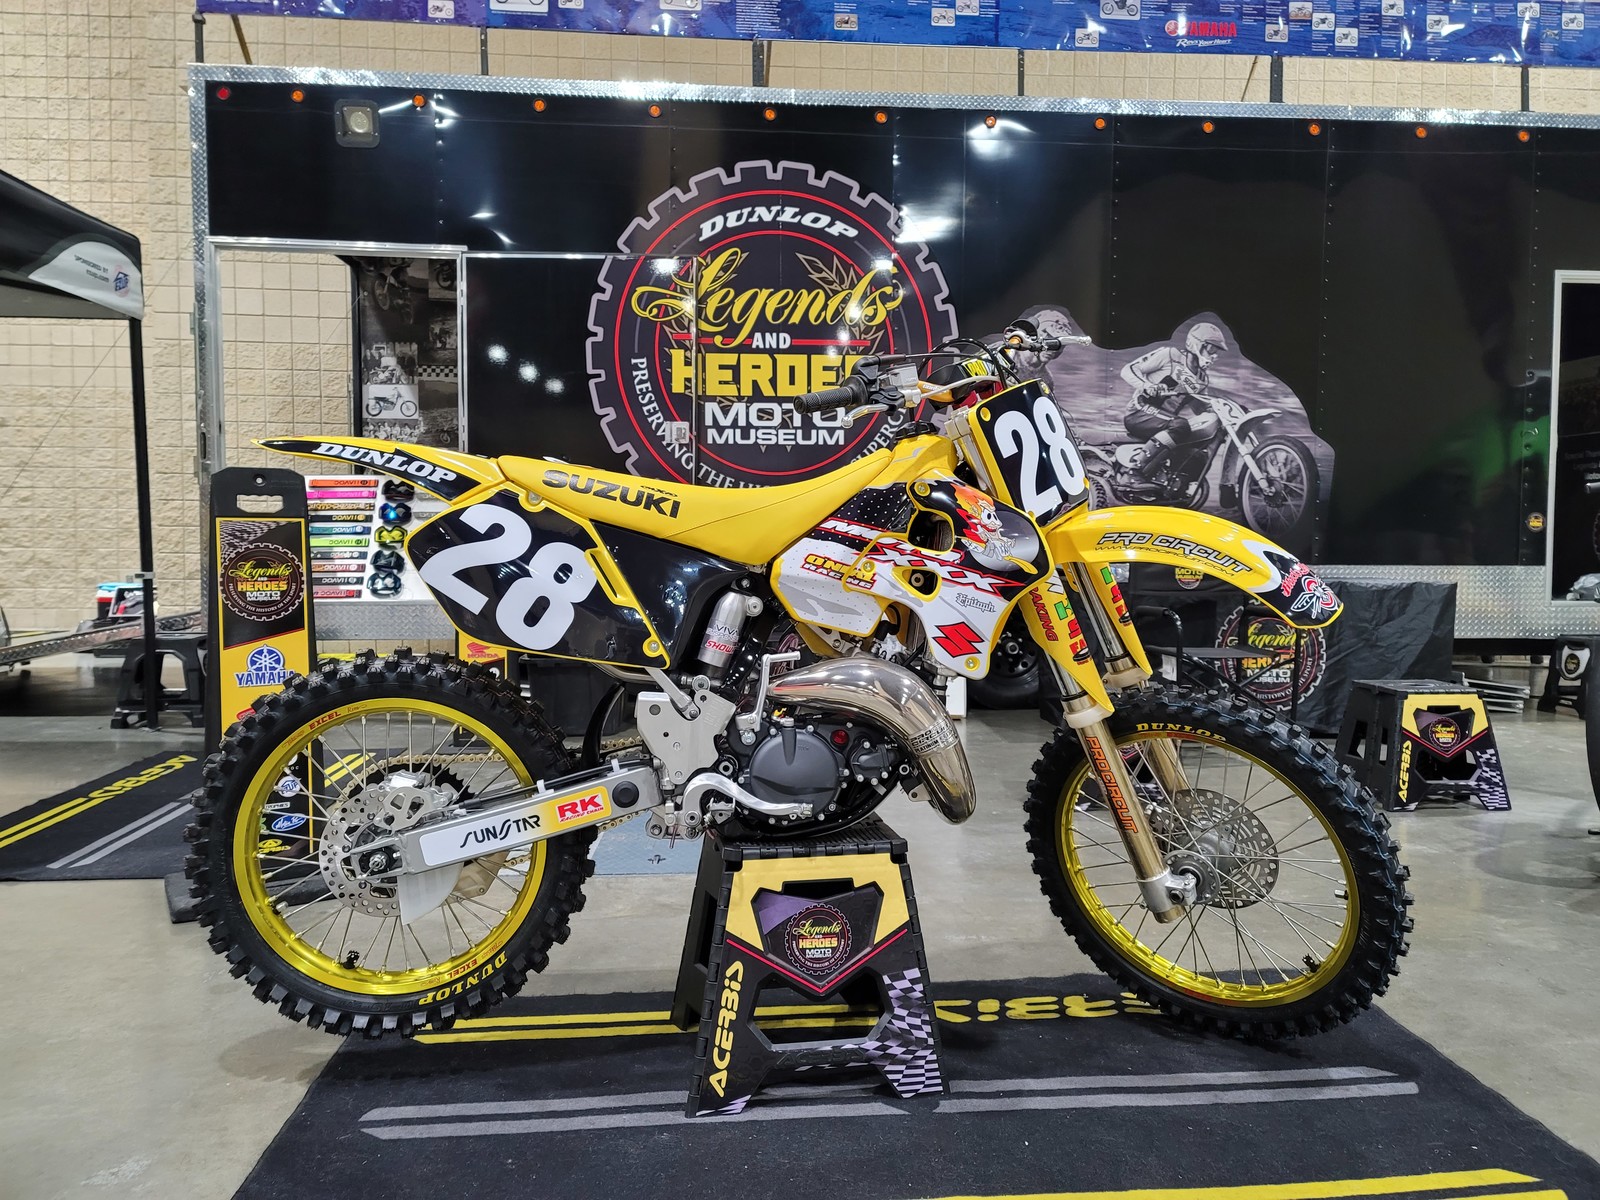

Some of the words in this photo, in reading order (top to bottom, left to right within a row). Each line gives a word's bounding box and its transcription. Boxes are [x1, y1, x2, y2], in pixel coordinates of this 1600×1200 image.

[700, 206, 859, 242] DUNLOP
[631, 247, 904, 347] Legends
[752, 333, 792, 349] AND
[671, 348, 866, 398] HEROE
[630, 357, 695, 469] PRESERVING
[697, 463, 735, 488] THE
[704, 402, 845, 427] MOTO
[706, 429, 845, 445] MUSEUM
[312, 443, 458, 483] DUNLOP
[993, 397, 1086, 518] 28
[542, 469, 682, 519] SUZUKI
[1098, 532, 1153, 545] PRO
[1152, 535, 1253, 573] CIRCUIT
[228, 560, 293, 580] Legends
[415, 503, 598, 650] 28
[802, 563, 874, 589] RACNG
[237, 581, 288, 592] HEROES
[1029, 587, 1059, 641] RAKING
[705, 640, 735, 654] SHOW
[308, 711, 341, 730] EXCEL
[1136, 723, 1227, 741] DUNLOP
[1398, 740, 1413, 802] ACERBIS
[557, 794, 602, 818] RK
[586, 807, 604, 815] CHAIN
[792, 919, 842, 938] Legends
[799, 938, 838, 948] HEROES
[418, 951, 508, 1005] DUNLOP
[446, 959, 478, 979] EXCEL
[933, 992, 1164, 1023] ERBIS
[709, 960, 744, 1097] ACERBIS
